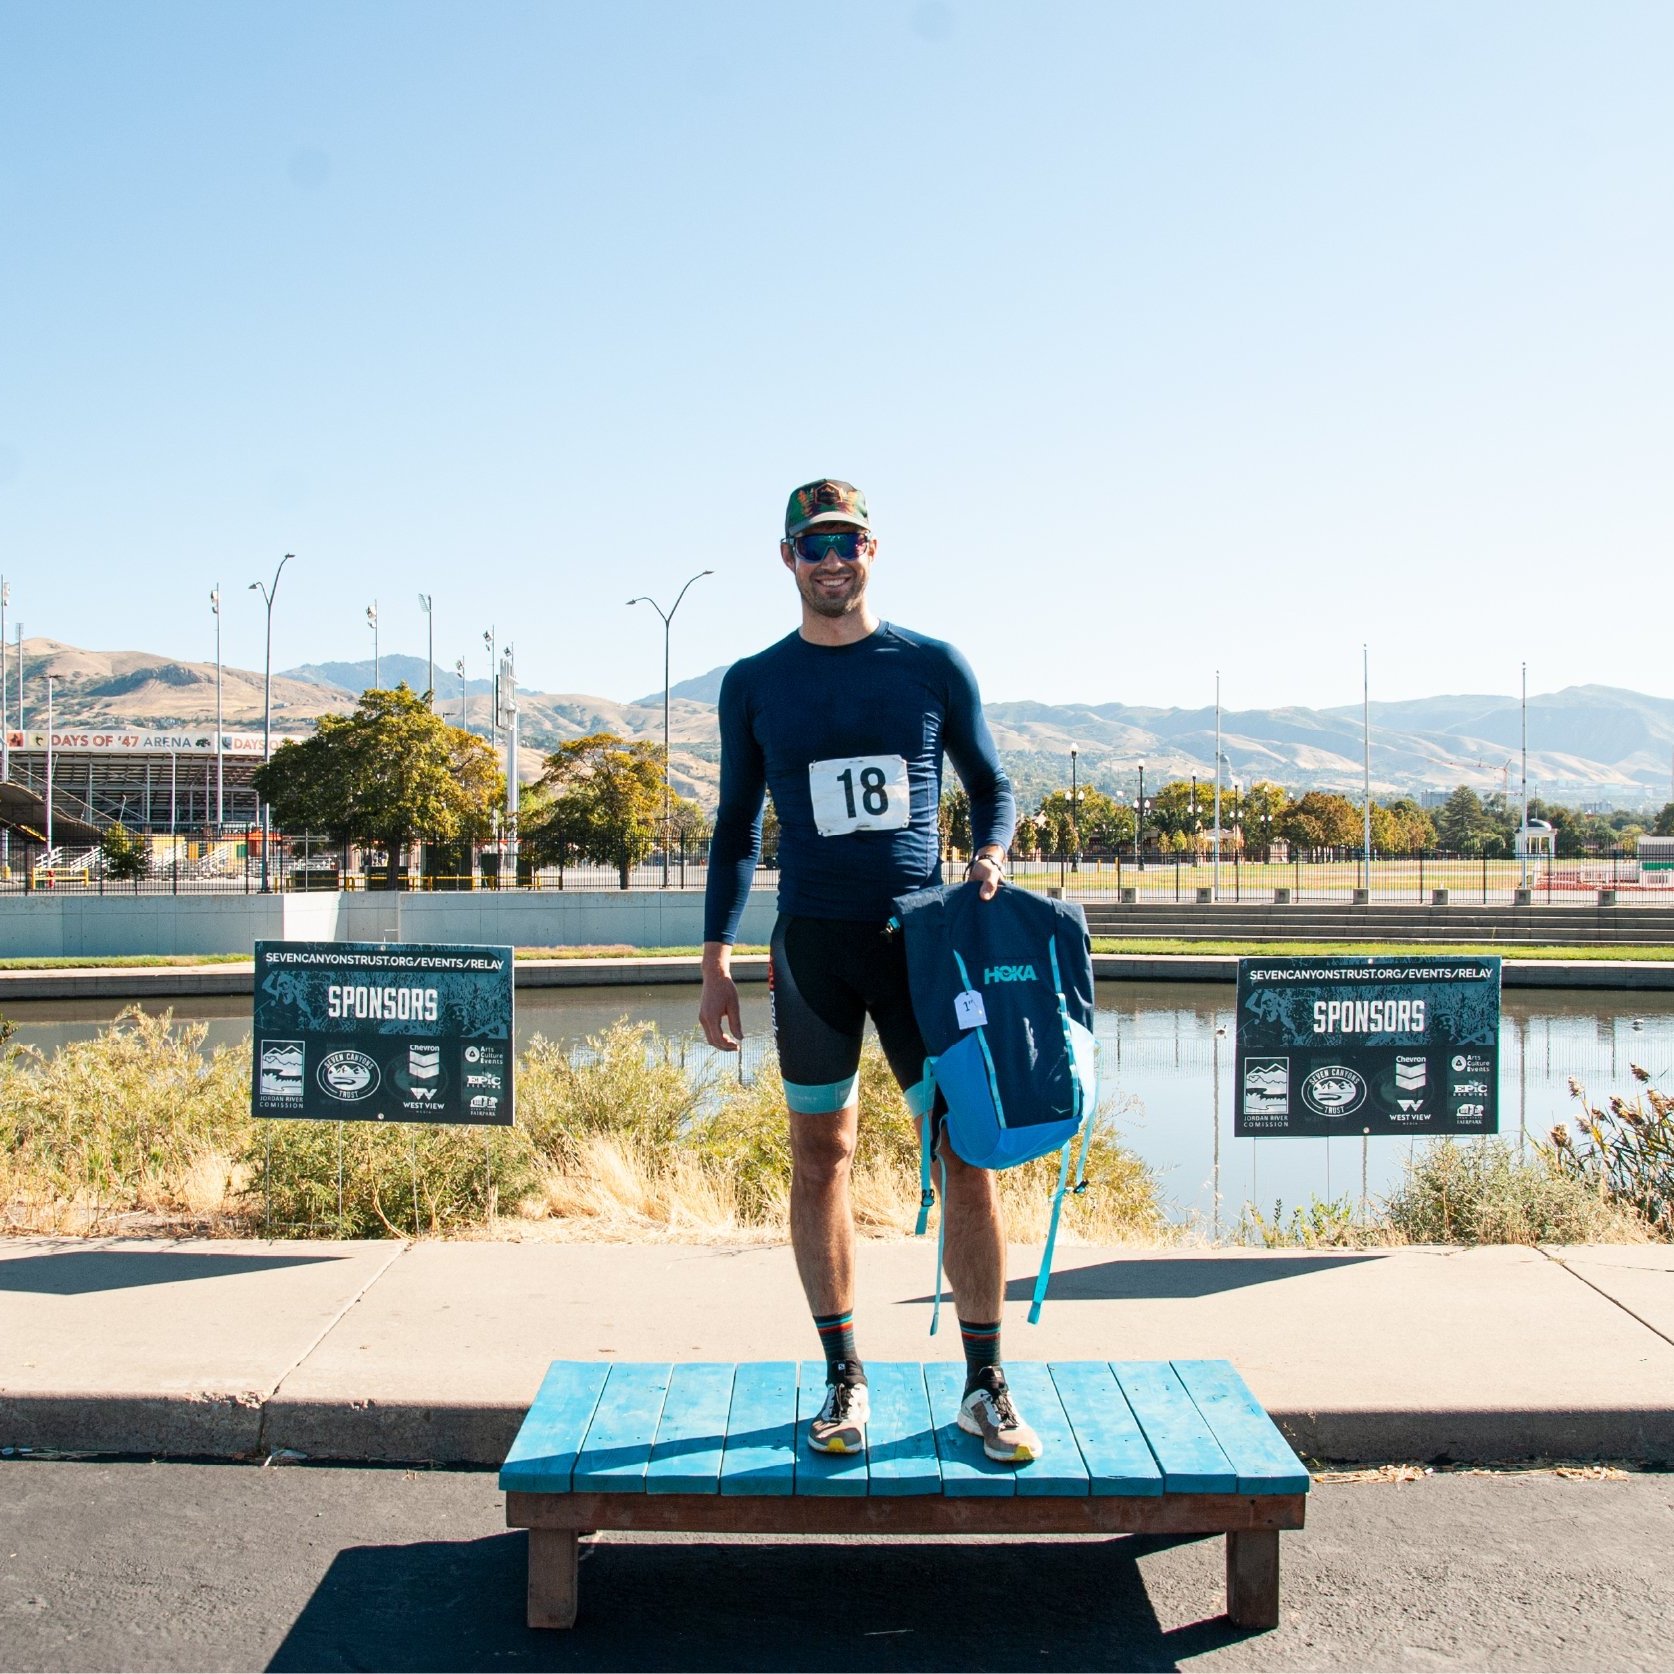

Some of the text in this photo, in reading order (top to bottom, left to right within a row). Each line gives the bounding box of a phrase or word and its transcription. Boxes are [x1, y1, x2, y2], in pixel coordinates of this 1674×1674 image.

[51, 734, 89, 747] DAYS
[93, 735, 114, 747] OF
[143, 736, 192, 748] ARENA
[234, 738, 265, 750] DAYS
[836, 767, 889, 818] 18
[265, 952, 504, 970] SEVENCANYONSTRUST.ORG/EVENTS/RELAY
[984, 964, 1038, 985] HOKA
[1250, 968, 1493, 980] SEVENCANYONSTRUST.ORG/EVENTS/RELAY
[328, 986, 438, 1021] SPONSORS
[1313, 1000, 1425, 1033] SPONSORS
[324, 1053, 374, 1070] SEVEN CANYONS
[1395, 1055, 1427, 1063] Chevron
[1309, 1068, 1360, 1085] SEVEN CANYONS
[339, 1090, 359, 1098] TRUST
[425, 1102, 445, 1110] VIEW
[1324, 1105, 1345, 1114] TRUST
